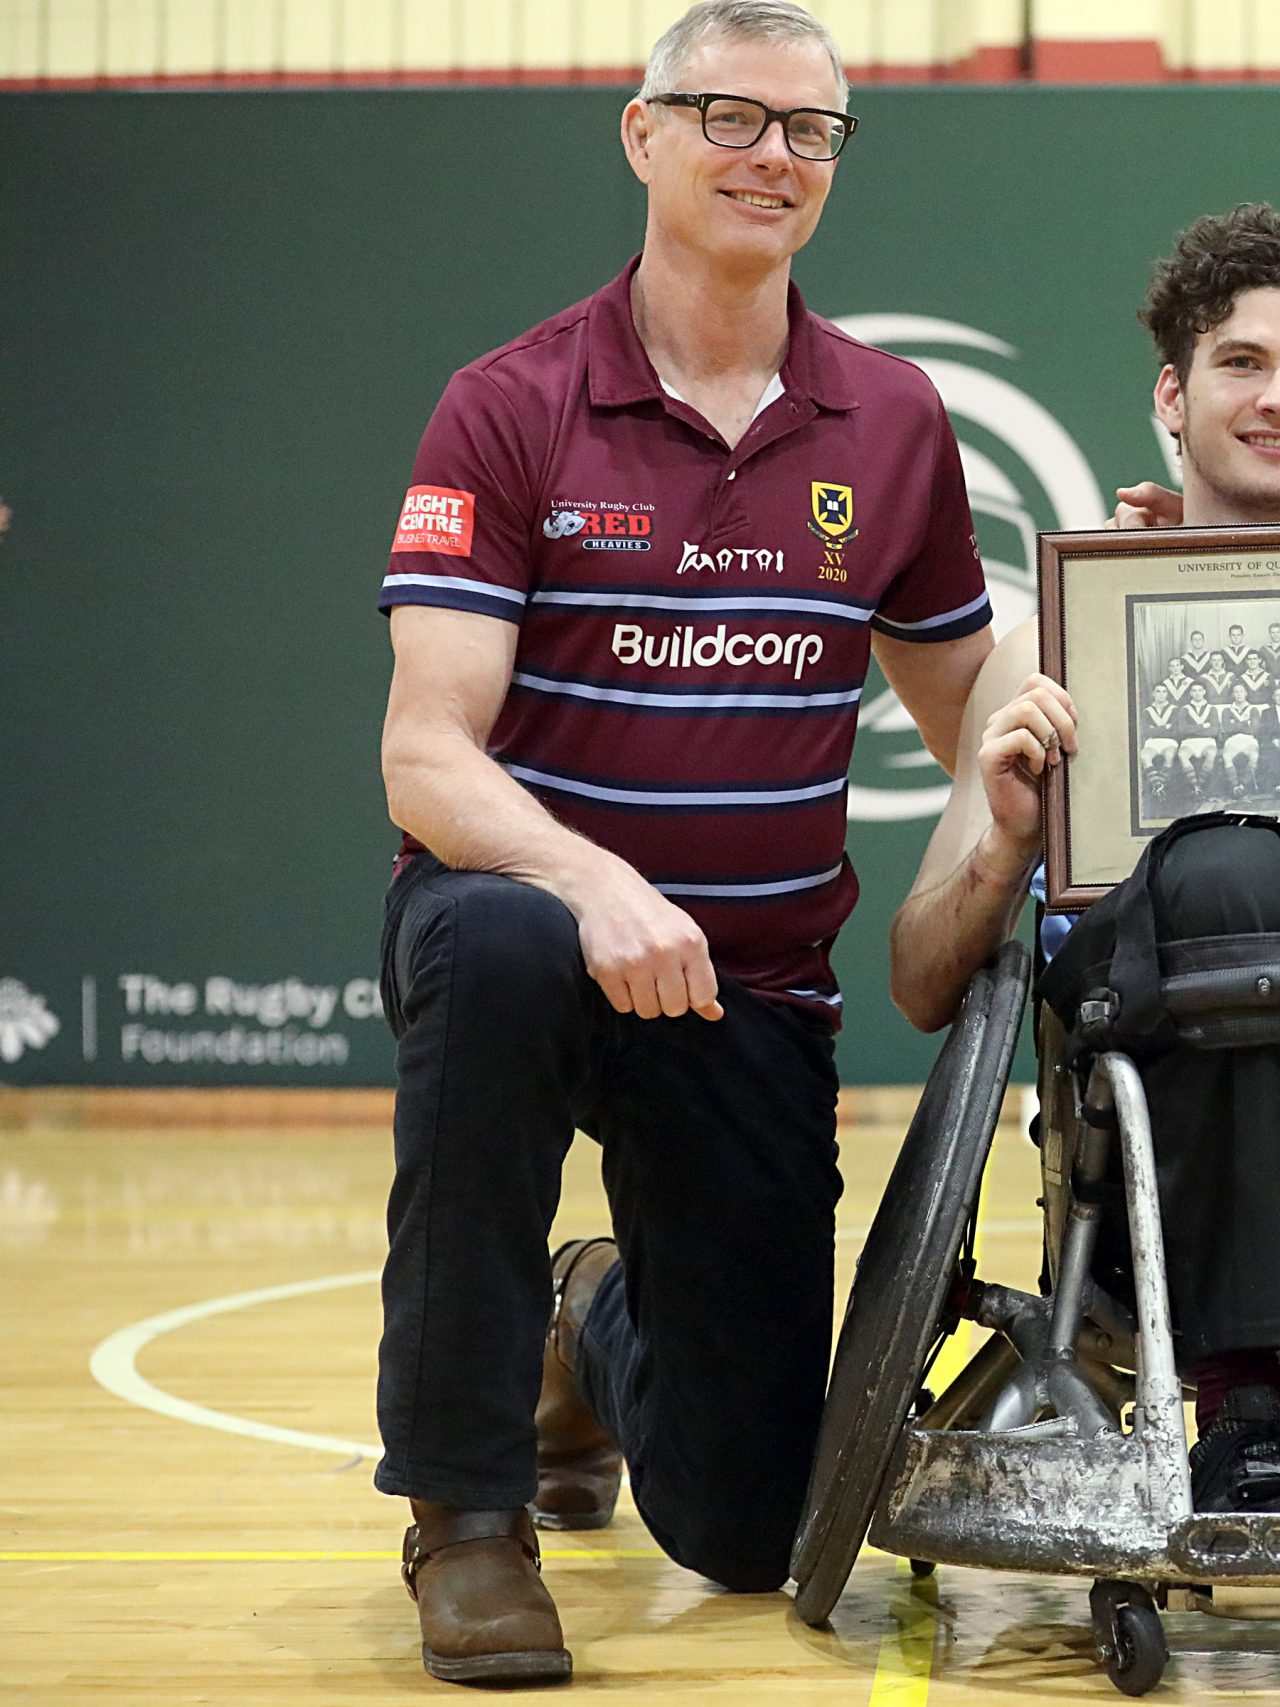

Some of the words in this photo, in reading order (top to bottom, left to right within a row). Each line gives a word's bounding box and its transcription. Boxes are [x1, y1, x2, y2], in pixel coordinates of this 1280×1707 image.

[551, 500, 597, 511] University
[600, 501, 630, 512] Rugby
[632, 503, 655, 511] Club
[400, 513, 463, 535] CENTRE
[579, 512, 651, 536] RED
[592, 541, 641, 549] HEAVIES
[823, 551, 845, 566] XV
[1178, 562, 1242, 572] UNIVERSITY
[1247, 561, 1262, 570] OF
[818, 566, 847, 583] 2020
[611, 623, 824, 680] Buildcorp
[118, 973, 198, 1016] The
[204, 976, 338, 1028] Rugby
[121, 1023, 350, 1067] Foundation
